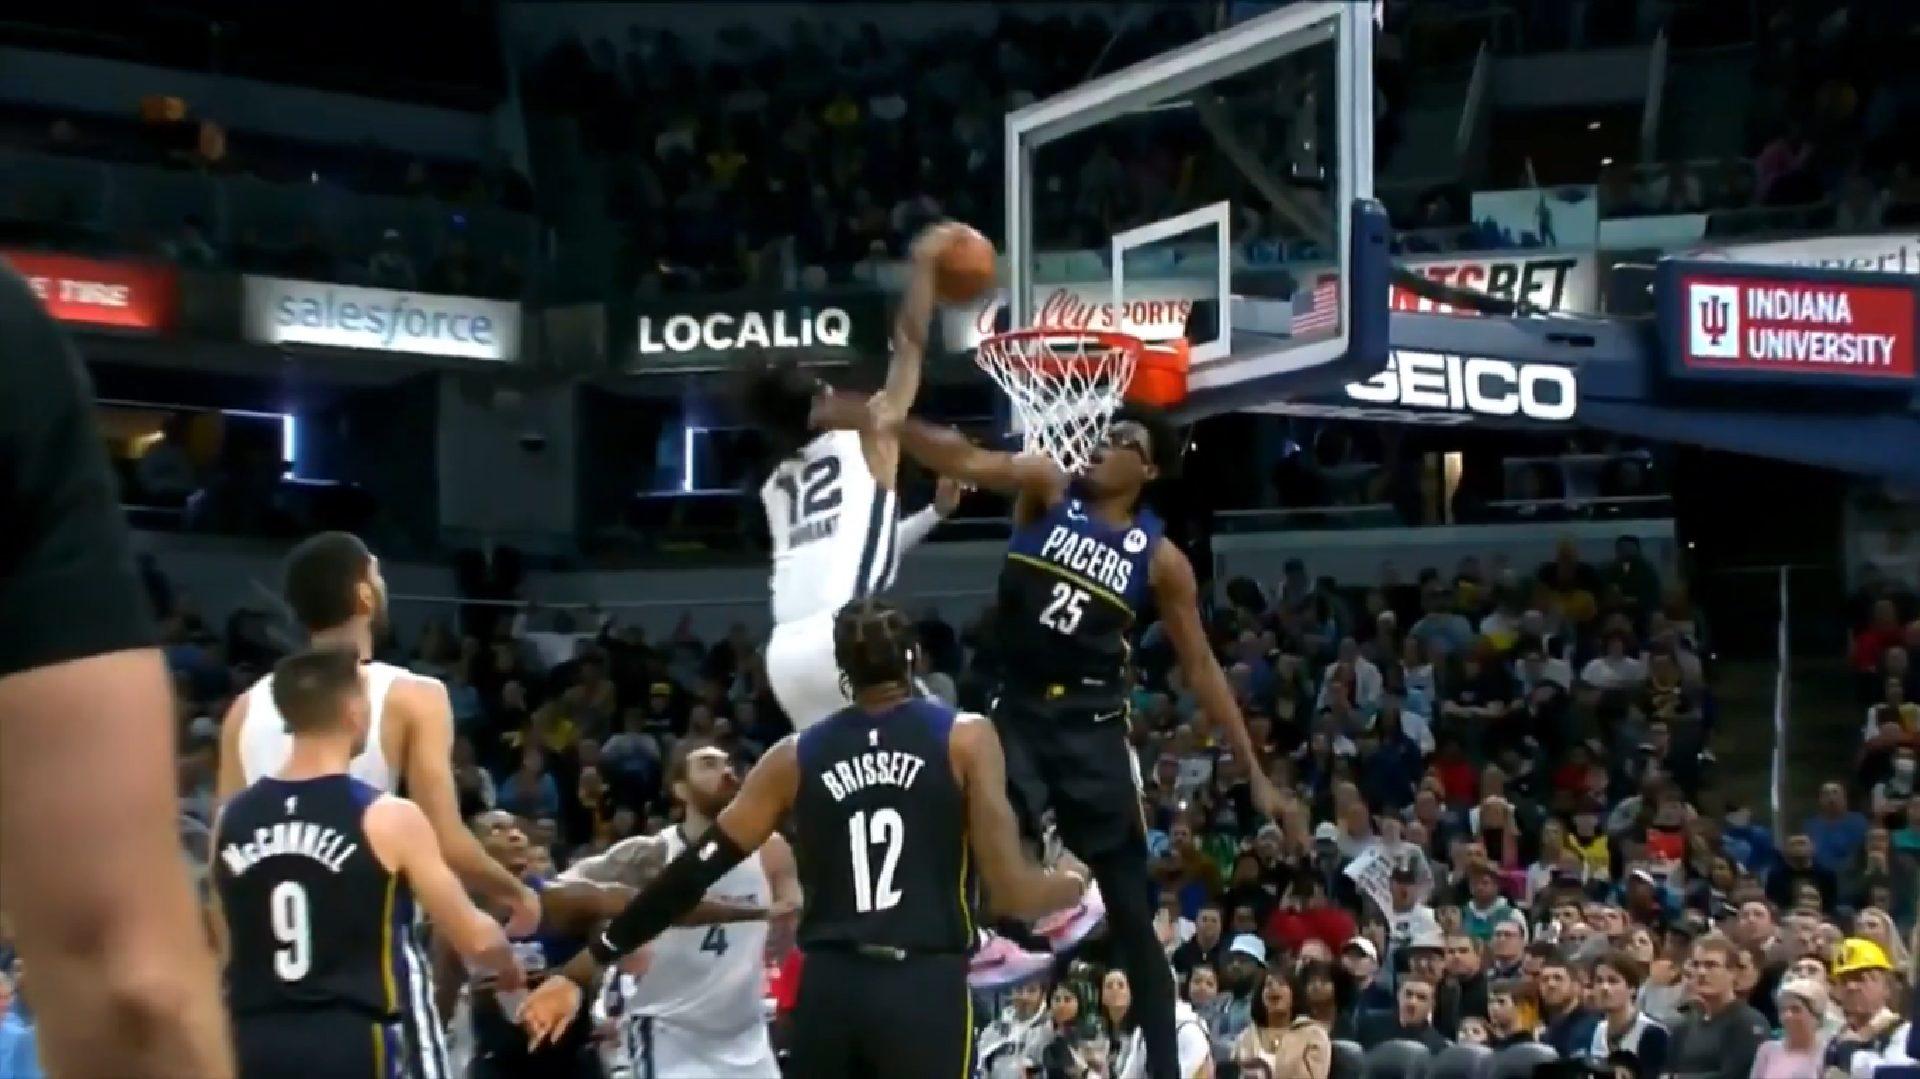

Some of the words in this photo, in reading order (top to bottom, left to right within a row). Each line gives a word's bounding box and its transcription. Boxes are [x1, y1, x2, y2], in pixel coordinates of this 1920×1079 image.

[272, 291, 493, 345] salesforce
[1747, 287, 1853, 324] INDIANA
[1748, 327, 1897, 366] UNIVERSITY
[774, 456, 842, 526] 12
[1040, 524, 1133, 595] PACERS
[1039, 582, 1091, 635] 25
[821, 750, 926, 802] BRISSETT
[849, 807, 904, 913] 12
[270, 880, 312, 982] 9
[700, 926, 729, 957] 4
